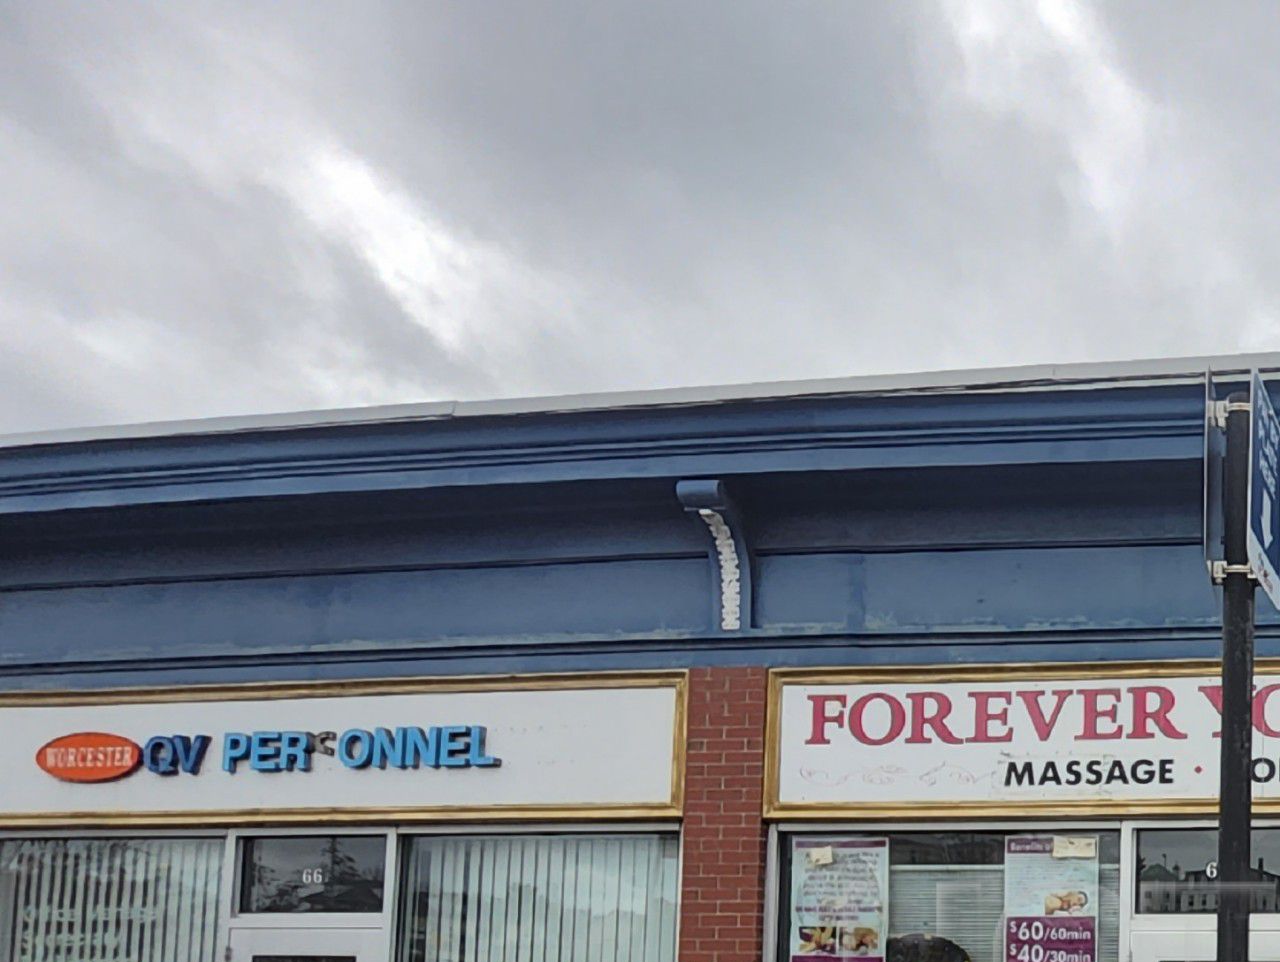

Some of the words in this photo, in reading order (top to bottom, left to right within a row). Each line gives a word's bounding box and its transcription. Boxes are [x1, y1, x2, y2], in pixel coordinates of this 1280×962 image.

[804, 685, 1188, 746] FOREVER
[45, 746, 133, 768] WORCESTER
[143, 735, 212, 776] QV
[1004, 758, 1175, 787] MASSAGE
[302, 868, 323, 884] 66
[1009, 920, 1092, 941] $60/60min
